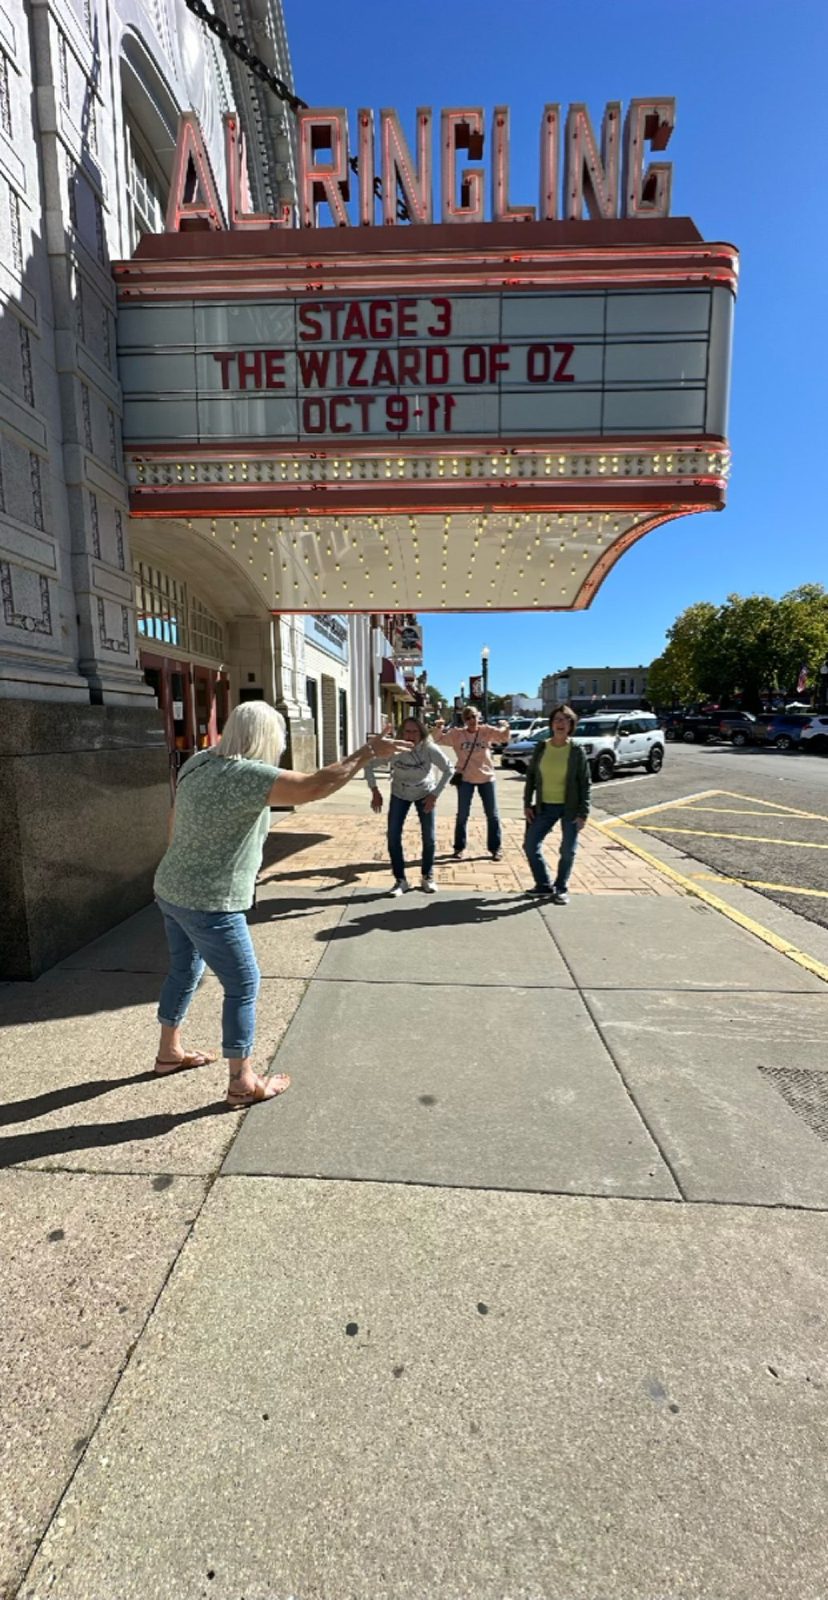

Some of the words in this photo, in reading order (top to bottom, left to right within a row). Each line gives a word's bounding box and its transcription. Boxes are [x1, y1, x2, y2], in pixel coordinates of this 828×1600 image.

[165, 111, 293, 232] AL
[297, 97, 676, 230] RINGLING
[299, 299, 418, 342] STAGE
[427, 297, 452, 338] 3
[213, 350, 286, 390] THE
[297, 346, 450, 389] WIZARD
[463, 343, 510, 385] OF
[527, 342, 576, 383] OZ
[303, 396, 376, 434] OCT
[386, 392, 457, 433] 9-11
